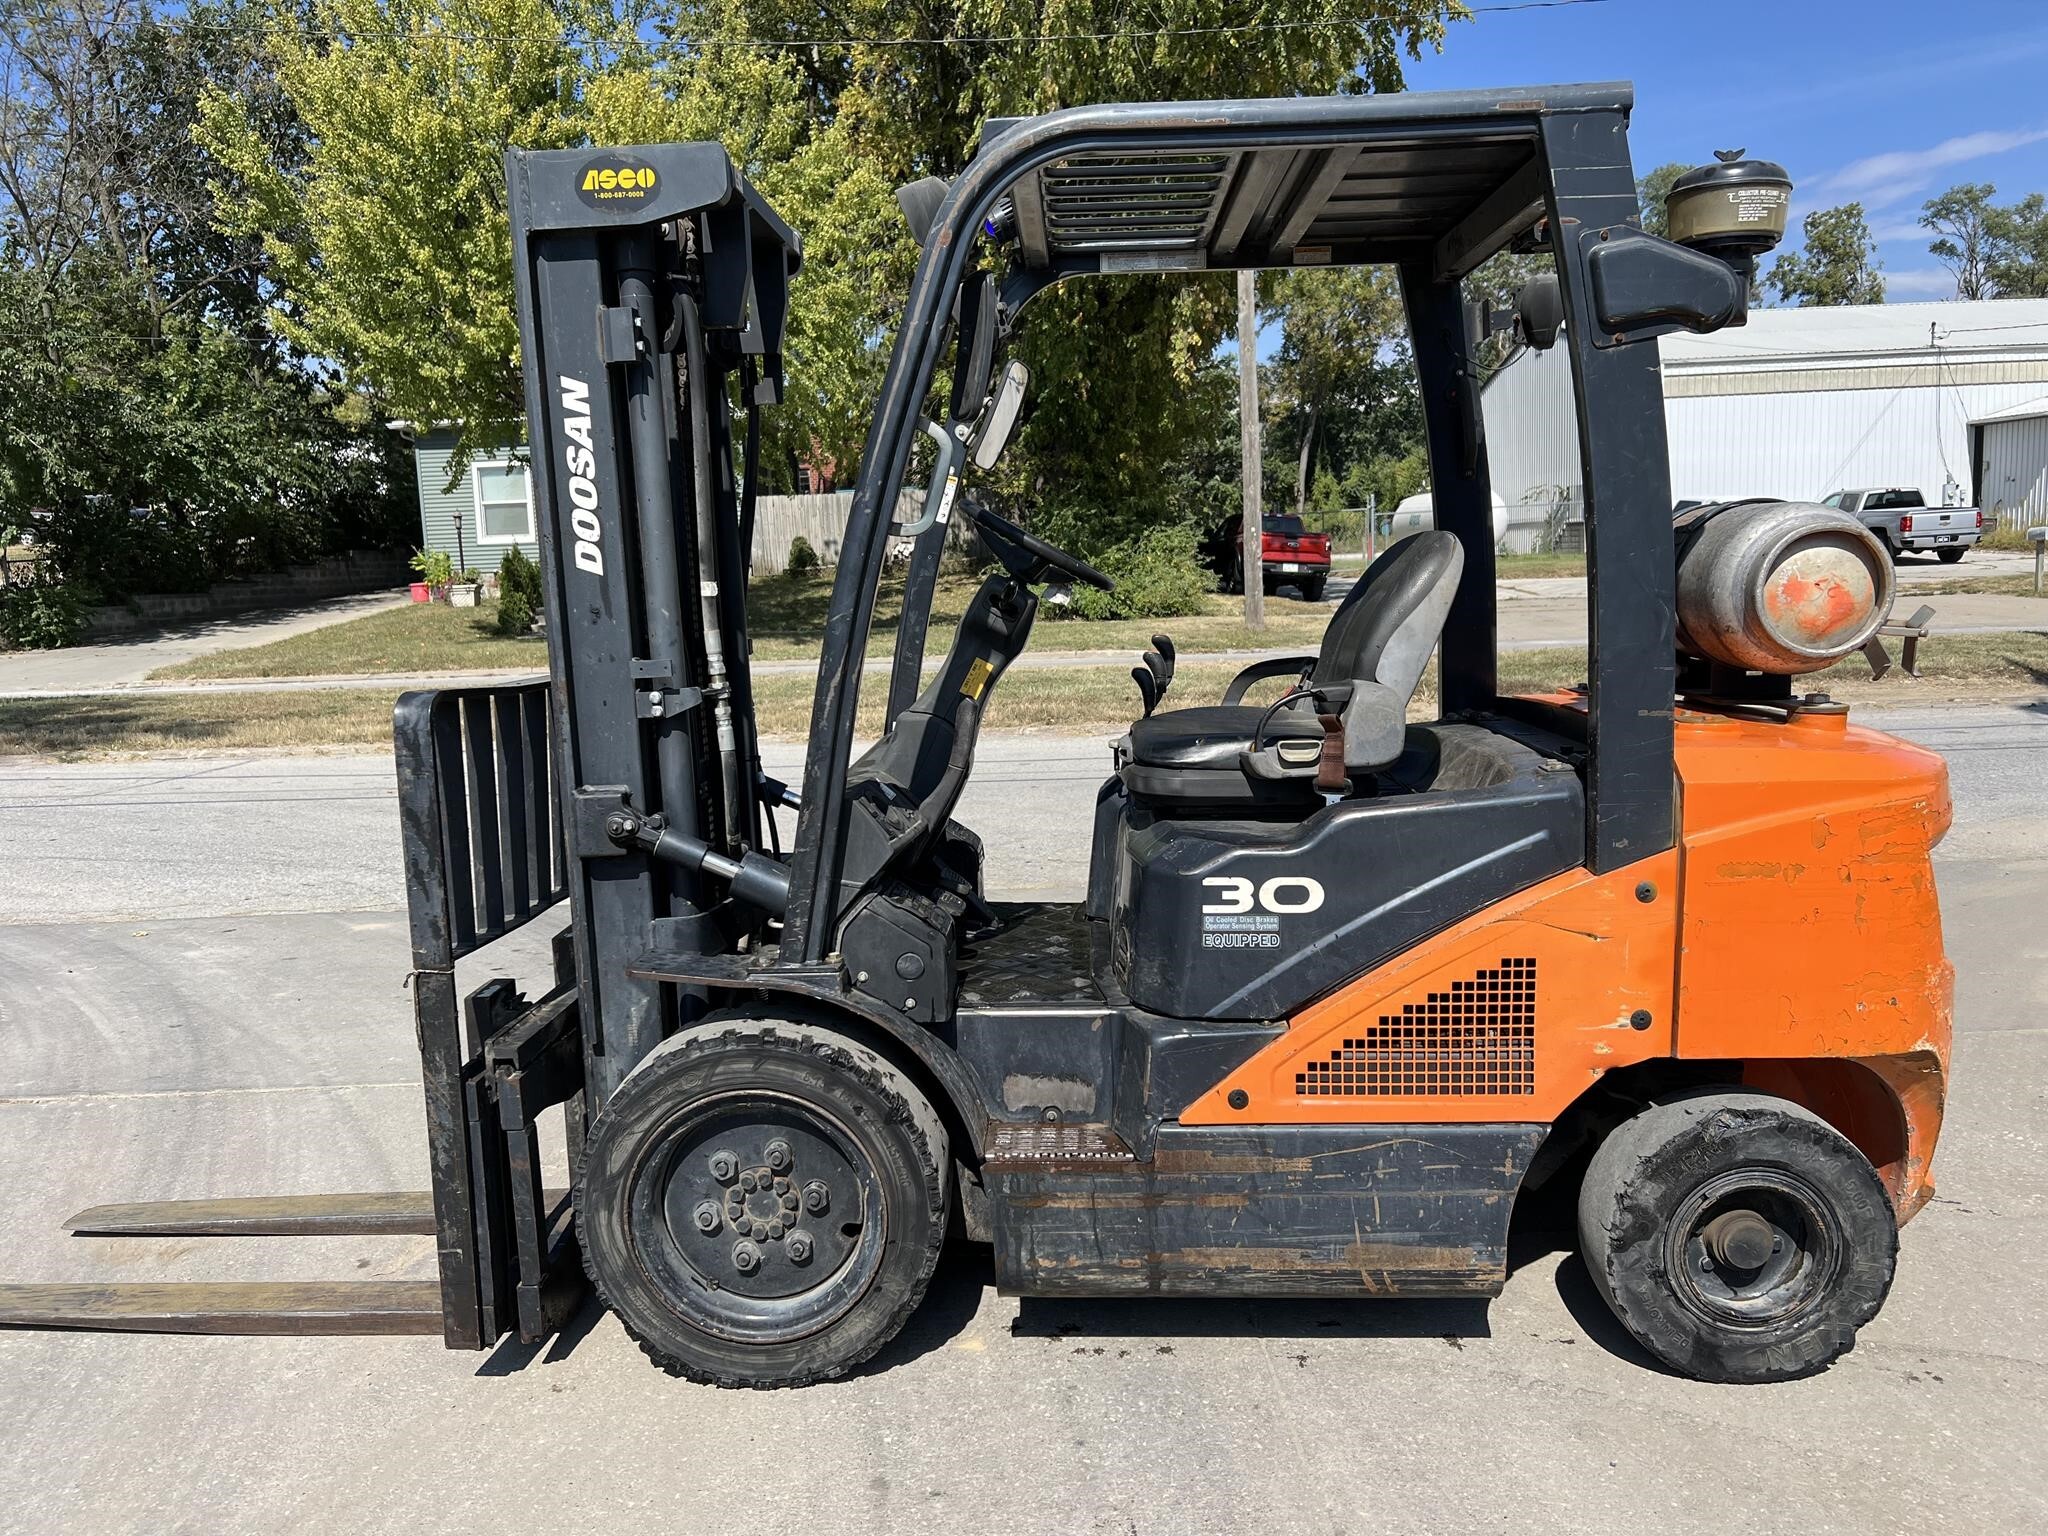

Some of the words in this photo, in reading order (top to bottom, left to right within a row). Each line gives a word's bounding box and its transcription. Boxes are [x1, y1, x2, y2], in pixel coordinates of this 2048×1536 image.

[582, 167, 656, 190] ASCO
[560, 375, 604, 576] DOOSAN
[1202, 876, 1325, 913] 30
[1205, 922, 1232, 931] Operator
[1232, 922, 1255, 931] Sensing
[1255, 922, 1278, 931] System
[1203, 933, 1280, 948] EQUIPPED
